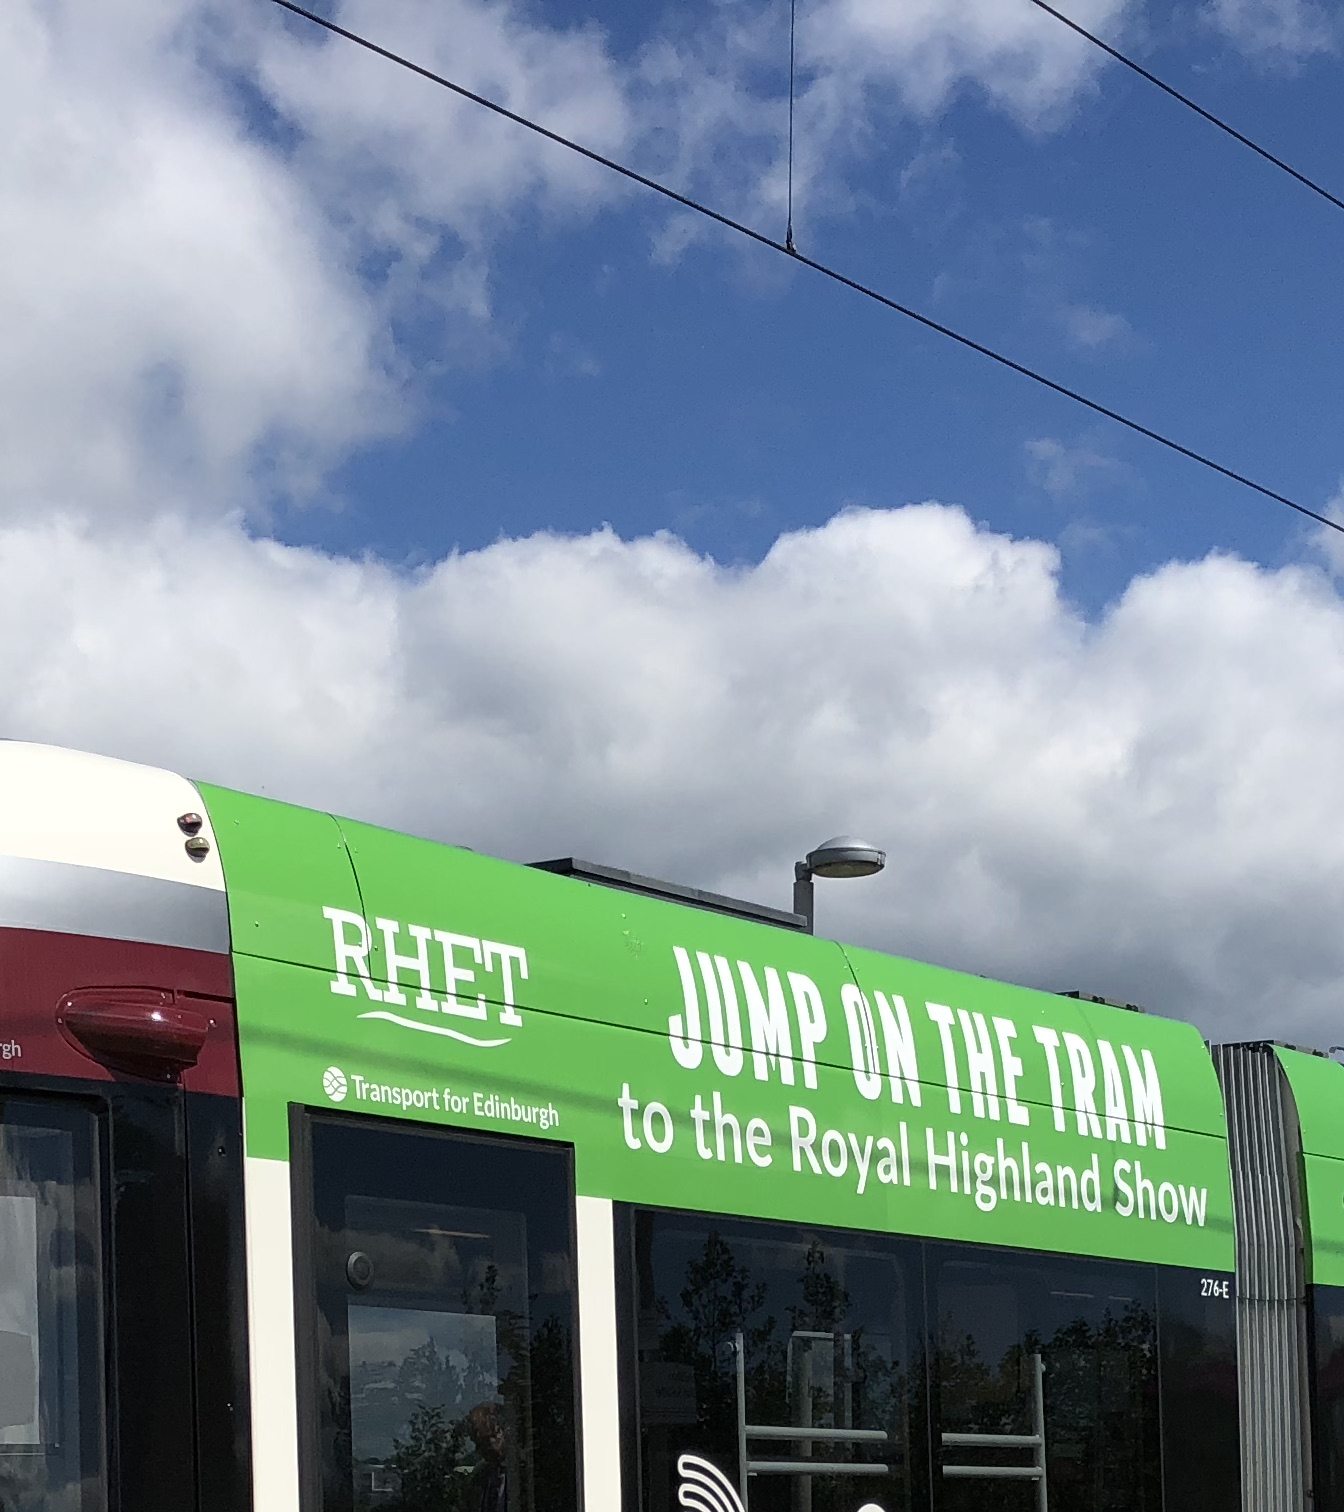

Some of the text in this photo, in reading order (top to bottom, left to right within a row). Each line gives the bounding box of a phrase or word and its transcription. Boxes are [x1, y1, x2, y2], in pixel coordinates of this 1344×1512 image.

[322, 906, 529, 1027] RHET
[350, 1074, 559, 1130] Transport for Edinburgh
[668, 946, 1166, 1150] JUMP ON THE TRAM
[618, 1083, 1207, 1227] to the Royal Highland Show
[1200, 1278, 1230, 1299] 276-E
